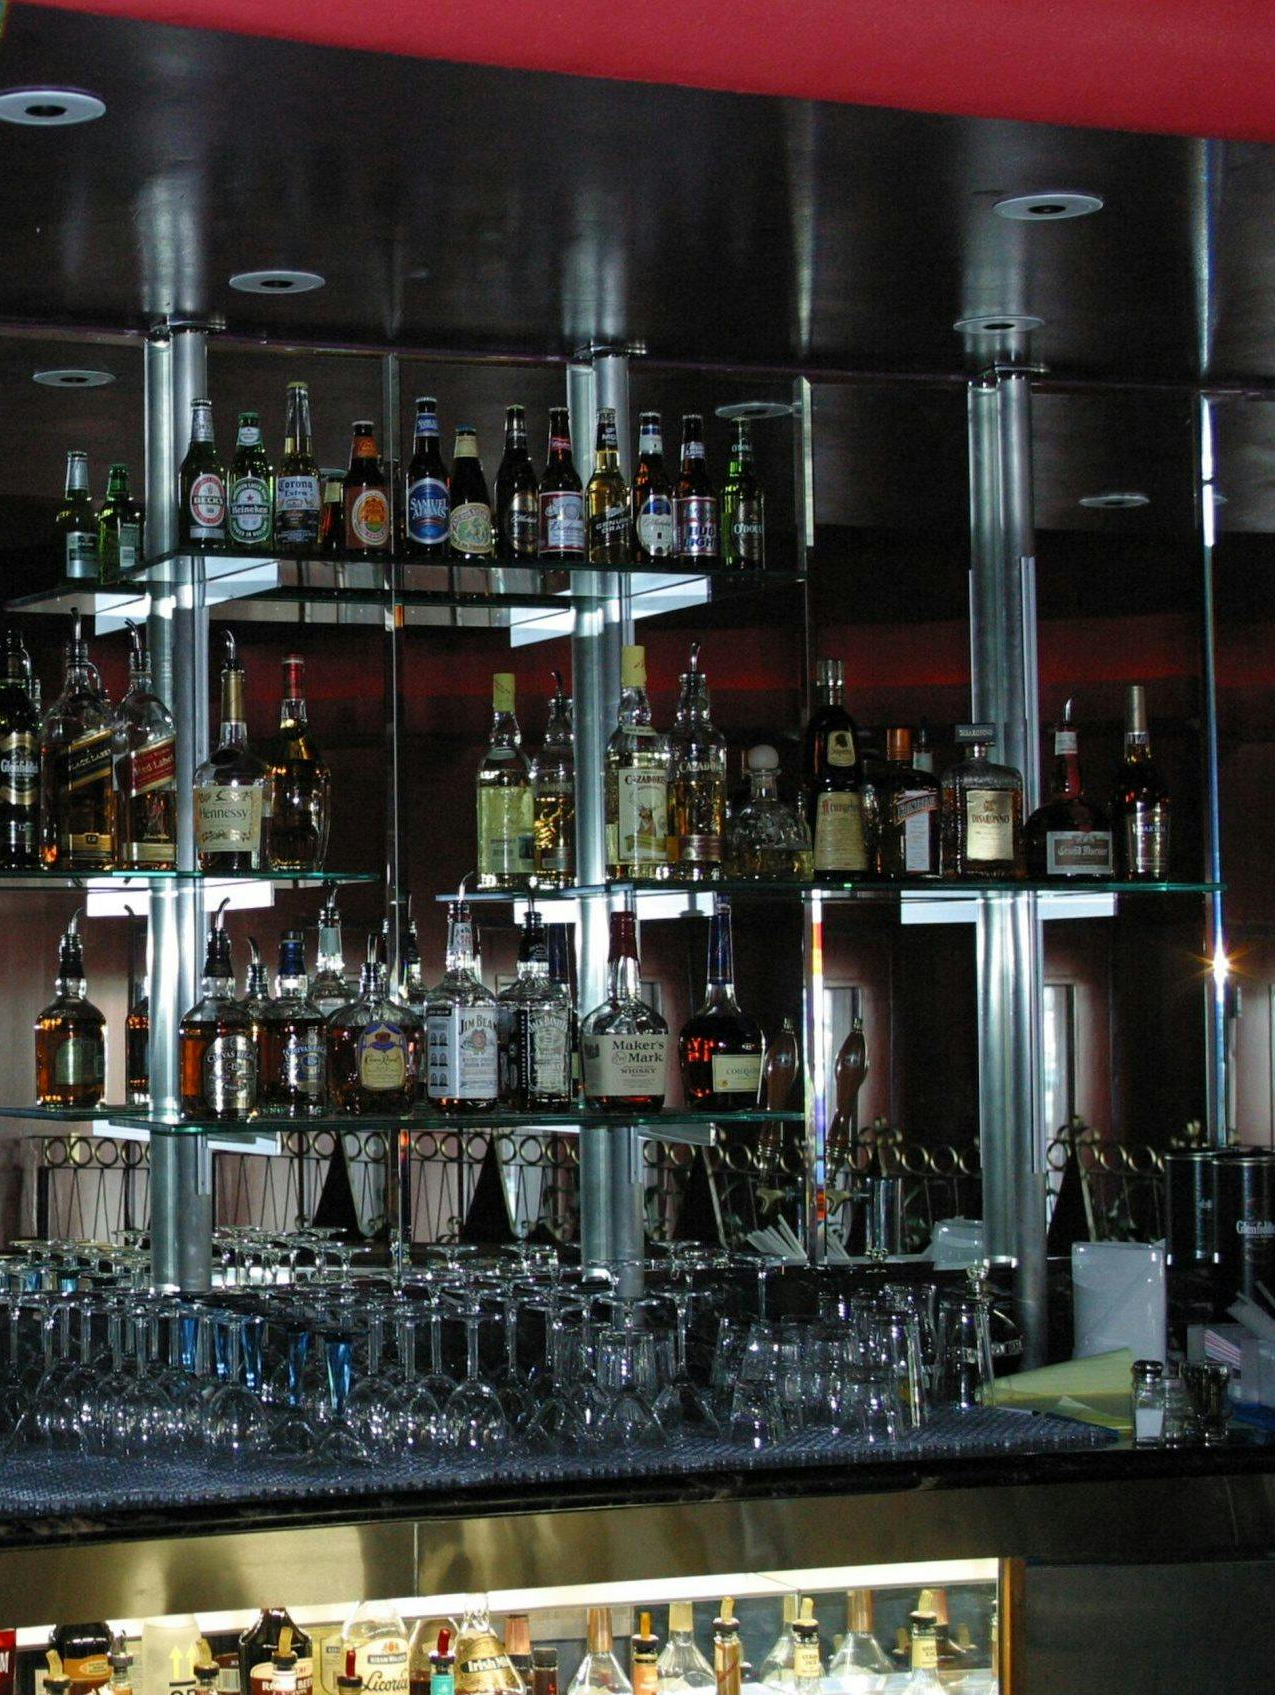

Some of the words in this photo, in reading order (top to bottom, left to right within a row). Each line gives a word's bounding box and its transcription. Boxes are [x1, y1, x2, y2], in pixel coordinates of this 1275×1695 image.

[278, 479, 312, 493] Corona
[232, 504, 268, 515] Heineken
[410, 497, 447, 511] SAMUEL
[411, 506, 447, 520] ADAMS
[199, 805, 247, 819] Hennessy
[459, 1018, 476, 1036] JIM
[612, 1040, 665, 1051] Maker's
[628, 1051, 664, 1063] Mark
[468, 1657, 496, 1673] Irish
